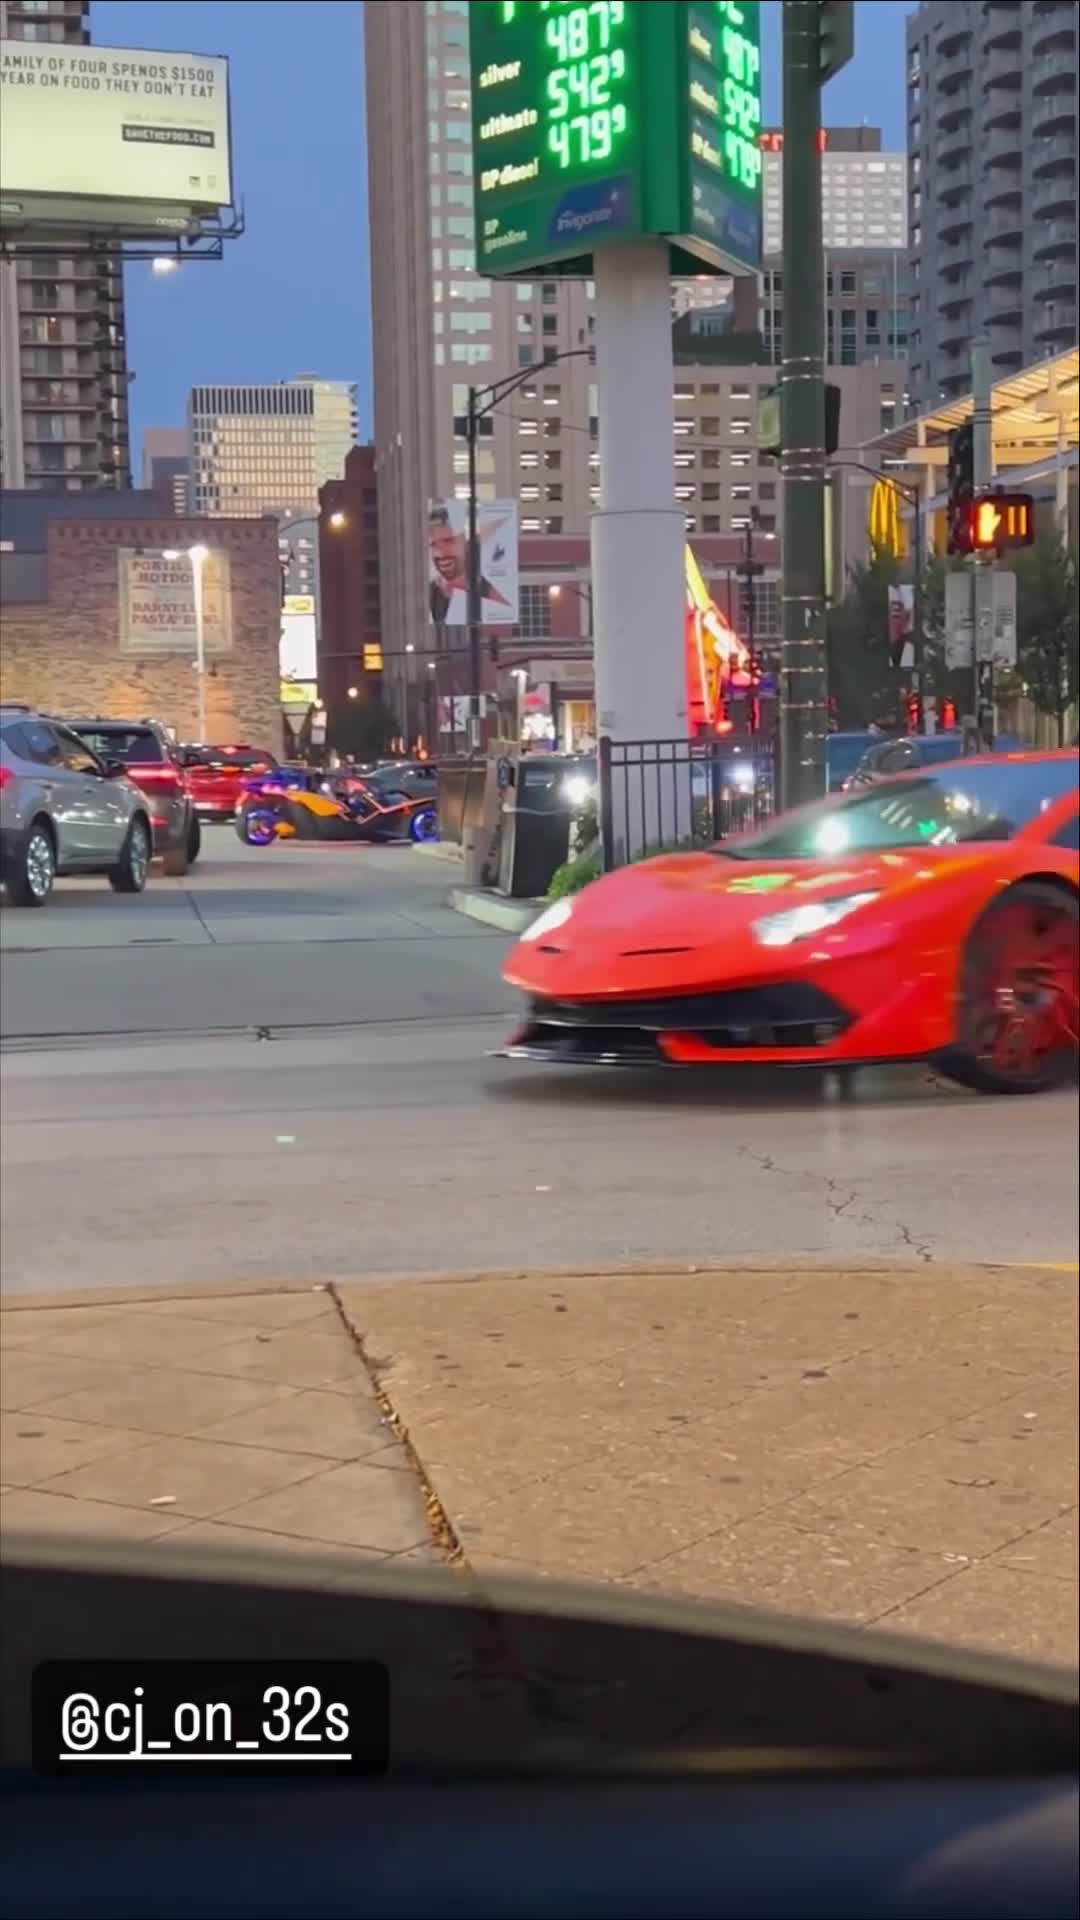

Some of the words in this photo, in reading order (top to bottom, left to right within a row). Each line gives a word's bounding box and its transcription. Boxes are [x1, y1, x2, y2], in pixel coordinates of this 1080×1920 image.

[1, 55, 43, 69] AMILY
[48, 57, 64, 71] OF
[70, 60, 107, 74] FOUR
[112, 62, 167, 80] SPENDS
[171, 65, 215, 83] $1500
[479, 61, 522, 88] silver
[548, 48, 626, 118] 5429
[1, 71, 35, 85] YEAR
[40, 73, 59, 87] ON
[63, 75, 100, 90] FOOD
[106, 78, 139, 92] THEY
[144, 81, 186, 97] DON'T
[191, 84, 215, 98] EAT
[549, 103, 626, 168] 4799
